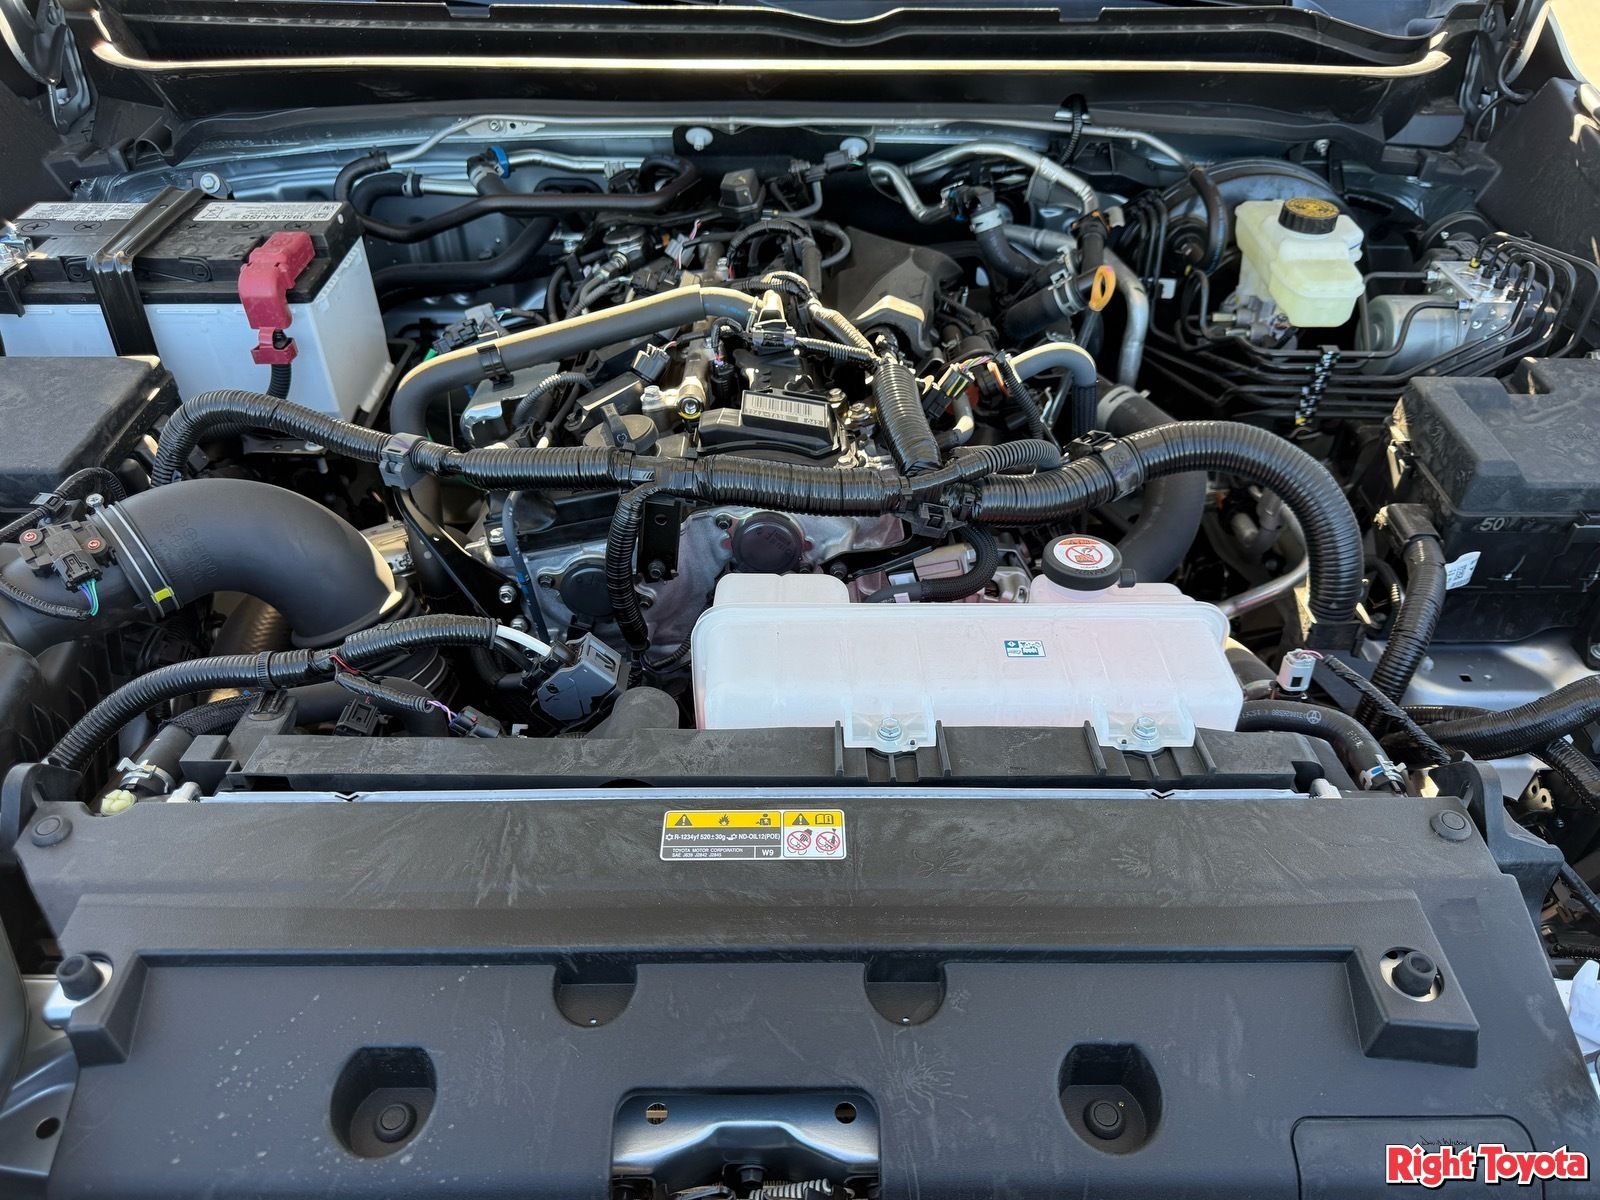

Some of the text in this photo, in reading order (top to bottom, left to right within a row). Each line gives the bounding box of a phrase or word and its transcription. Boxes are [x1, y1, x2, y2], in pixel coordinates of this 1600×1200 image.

[1480, 517, 1505, 531] 50
[674, 833, 699, 841] R-1234yf
[738, 833, 780, 841] ND-OIL12(POE)
